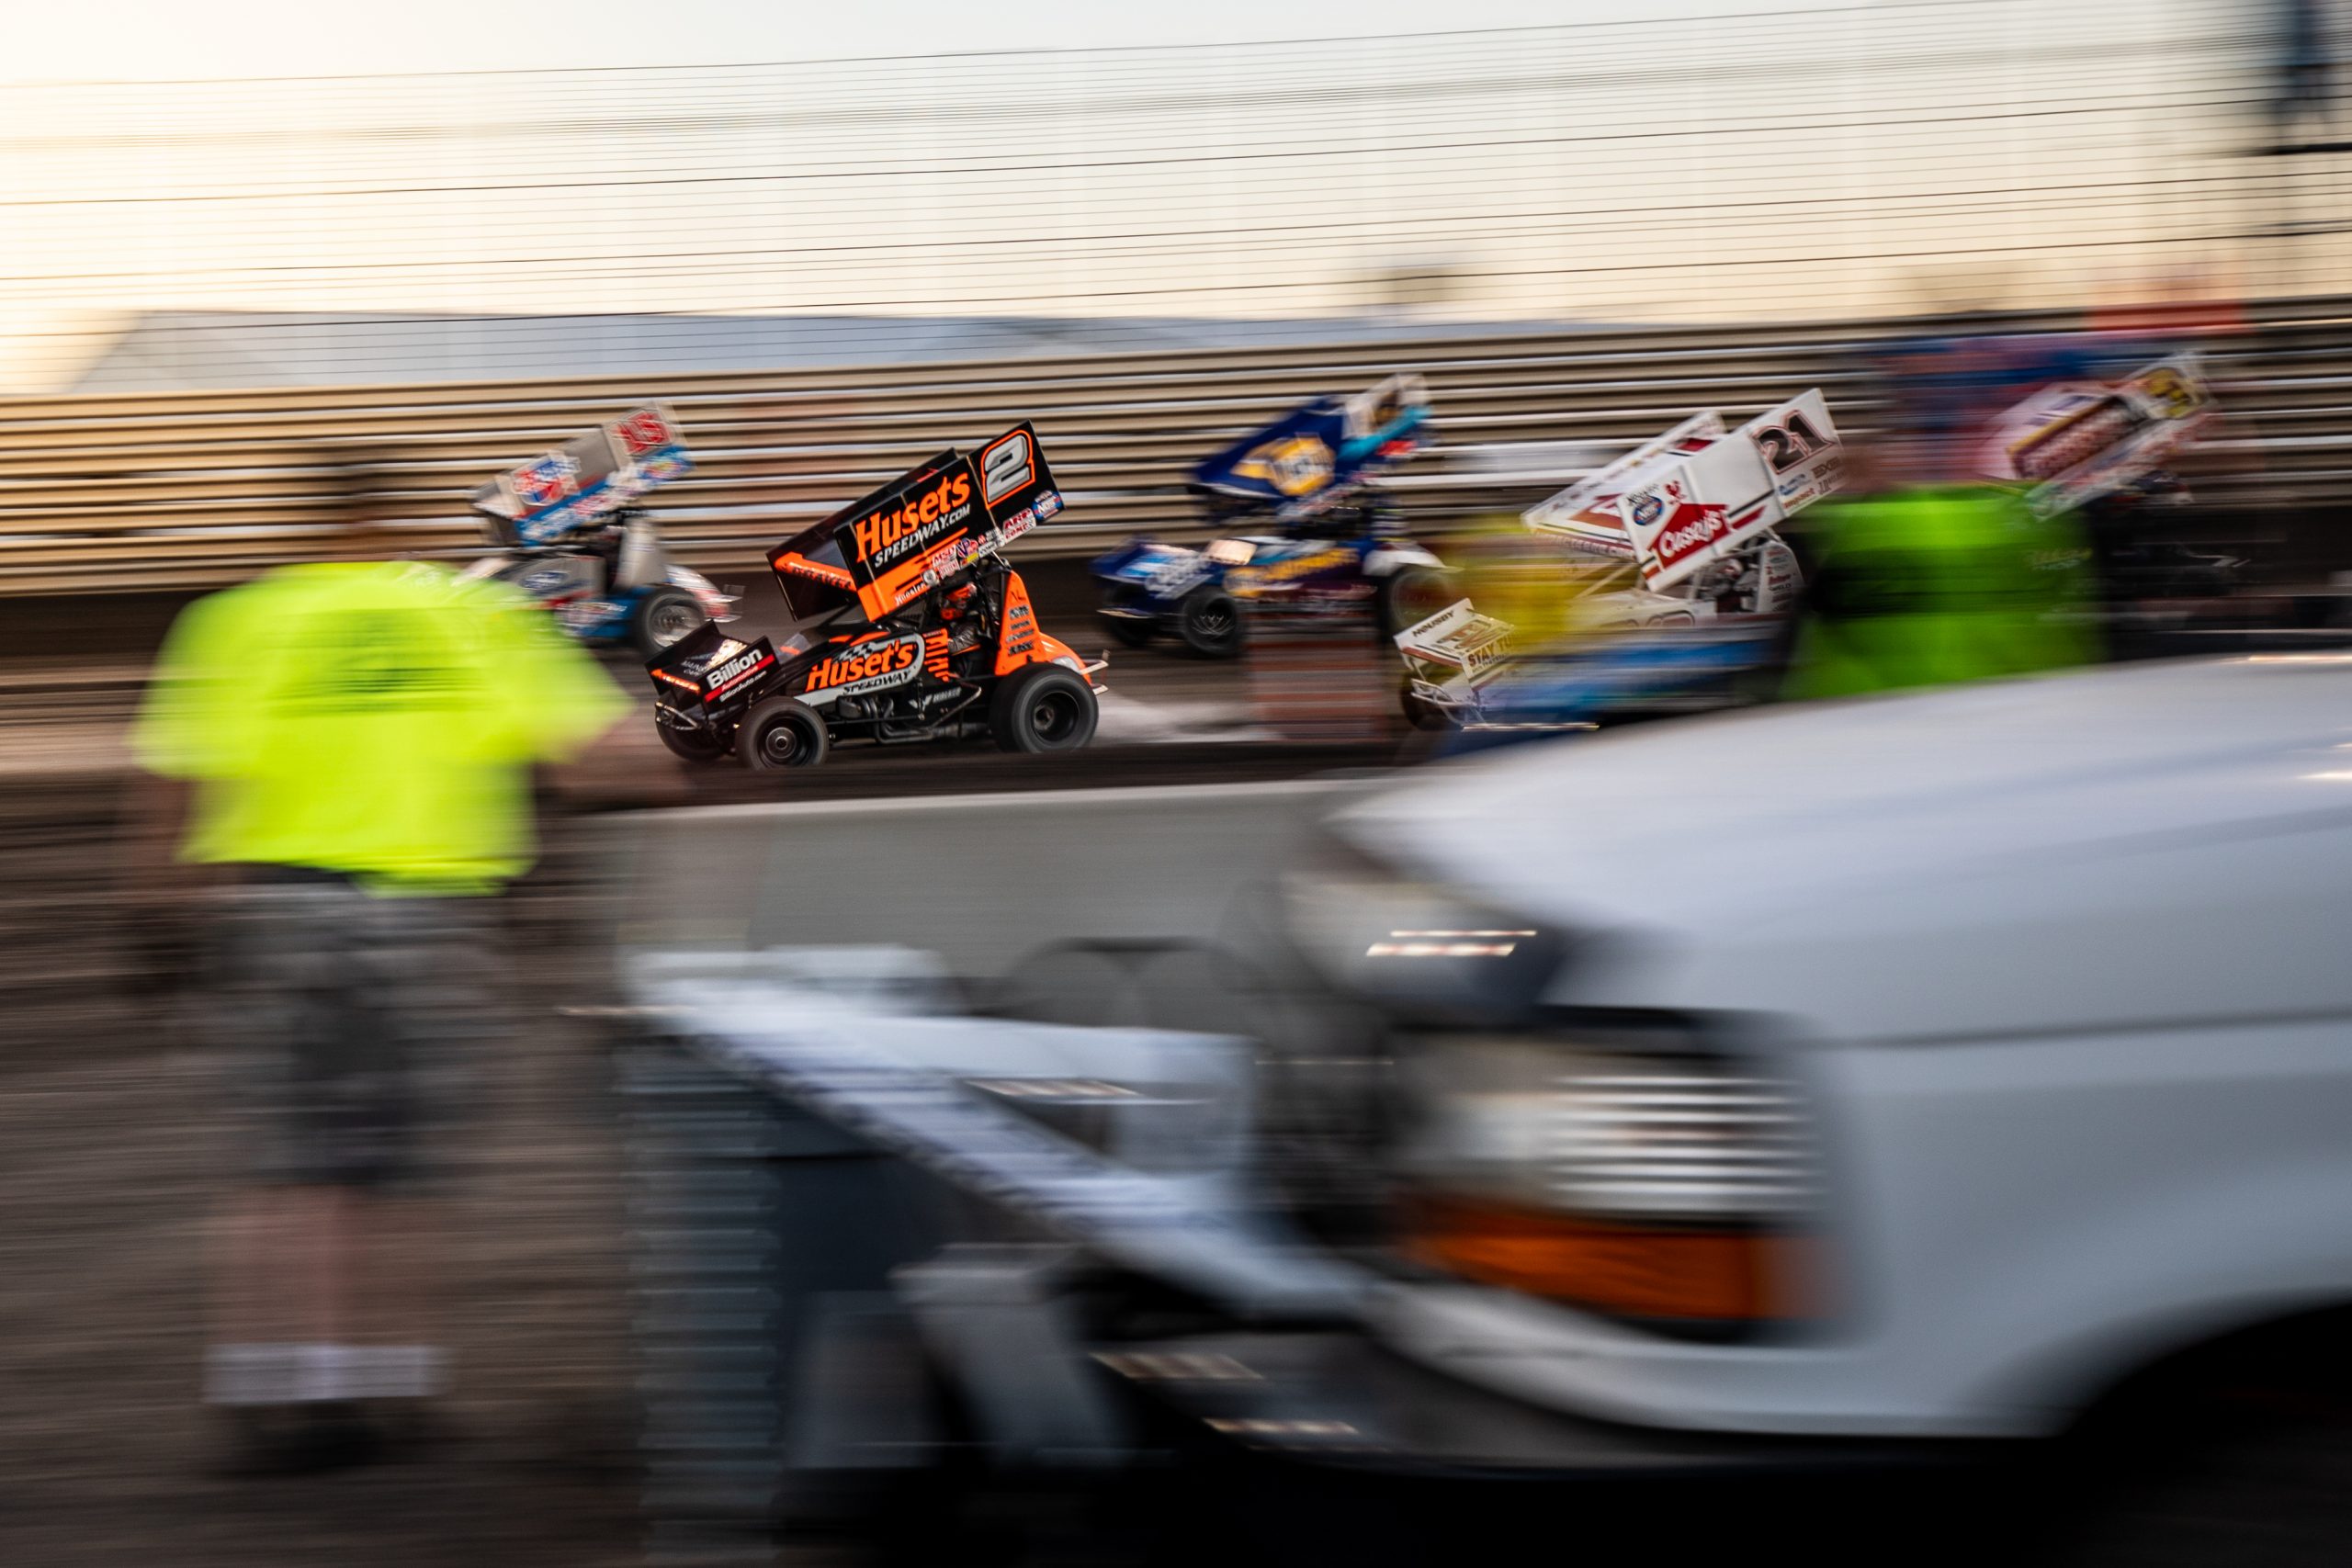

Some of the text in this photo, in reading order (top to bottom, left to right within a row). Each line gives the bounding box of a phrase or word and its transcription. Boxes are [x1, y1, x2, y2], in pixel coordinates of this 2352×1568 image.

[1755, 412, 1831, 472] 21
[983, 433, 1033, 506] 2
[855, 472, 971, 563] Husets
[874, 503, 971, 569] SPEEDWAY.COM
[894, 581, 926, 606] Hoosier
[707, 649, 763, 690] Billion
[805, 639, 914, 693] Huset's
[1467, 644, 1496, 667] STAY
[719, 671, 767, 702] BillionAuto.com
[721, 665, 759, 692] Automotive
[842, 670, 911, 694] SPEEDWAY
